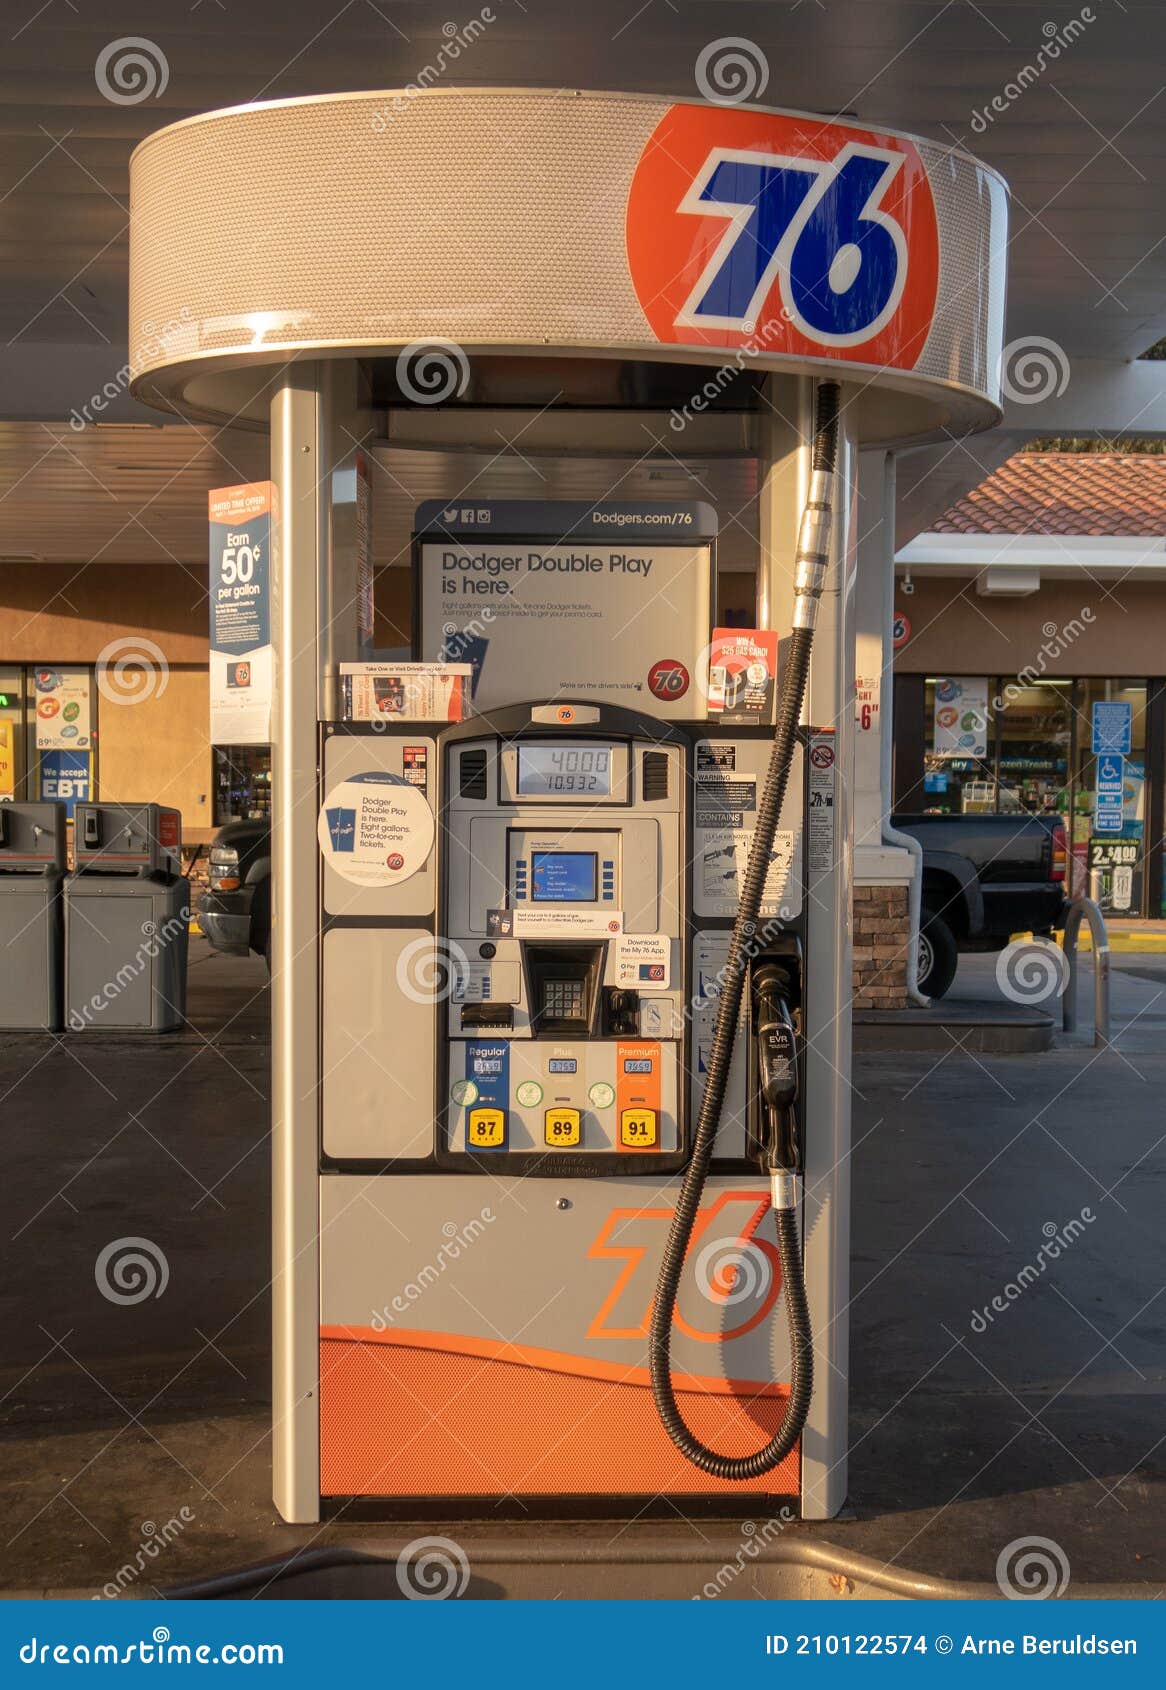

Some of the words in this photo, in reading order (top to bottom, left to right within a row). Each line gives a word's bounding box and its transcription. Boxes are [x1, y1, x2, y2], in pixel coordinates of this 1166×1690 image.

[672, 141, 908, 347] 76
[592, 511, 692, 526] Dodgers.com/76
[442, 552, 522, 576] Dodger
[527, 553, 603, 573] Double
[609, 554, 652, 576] Play
[218, 587, 232, 600] per
[234, 584, 260, 600] gallon
[442, 576, 456, 594] is
[462, 576, 514, 594] here.
[736, 636, 748, 646] WIN
[736, 647, 748, 656] GAS
[656, 668, 684, 692] 76
[560, 710, 571, 718] 76
[44, 768, 56, 776] We
[60, 768, 87, 778] accept
[42, 779, 88, 798] EBT
[548, 776, 597, 790] 10.932
[362, 797, 392, 806] Dodger
[362, 806, 390, 814] Double
[391, 808, 407, 816] Play
[360, 823, 380, 831] Eight
[1092, 846, 1104, 865] 2
[470, 1048, 506, 1057] Regular
[619, 1048, 659, 1056] Premium
[477, 1122, 496, 1136] 87
[553, 1122, 572, 1136] 89
[629, 1122, 648, 1136] 91
[584, 1191, 783, 1343] 76
